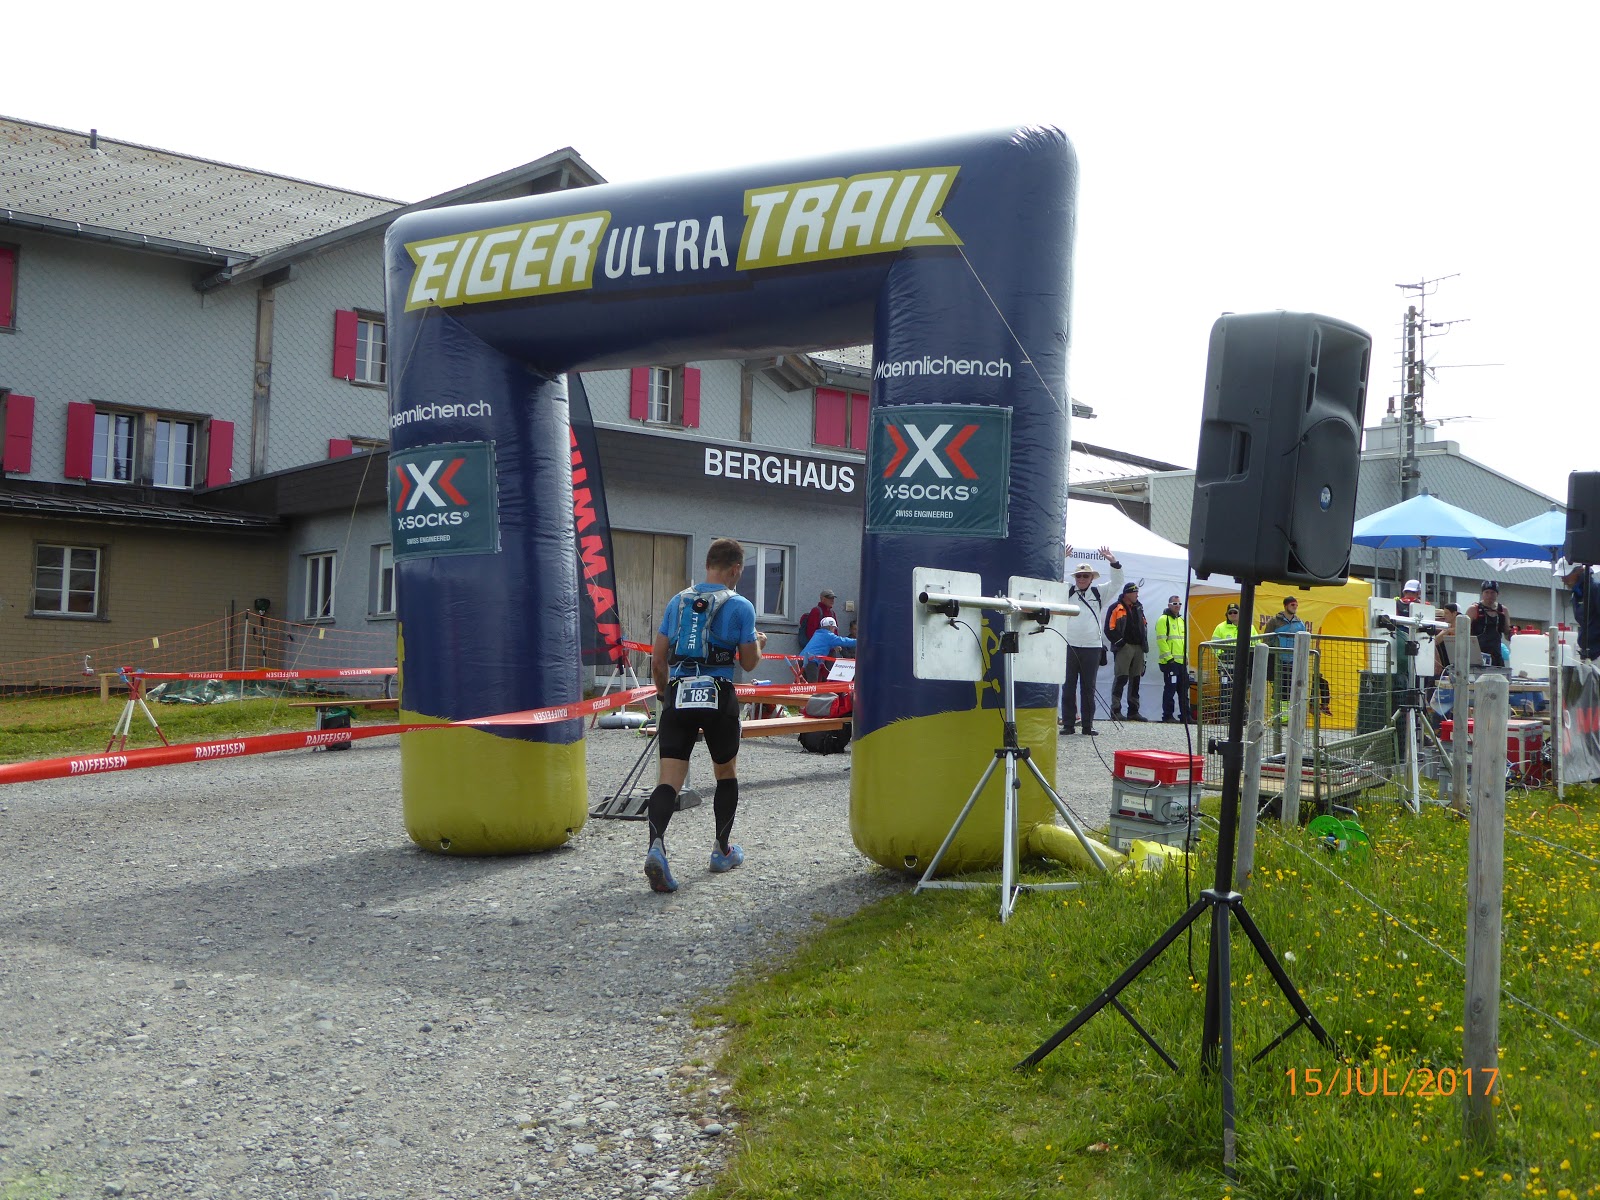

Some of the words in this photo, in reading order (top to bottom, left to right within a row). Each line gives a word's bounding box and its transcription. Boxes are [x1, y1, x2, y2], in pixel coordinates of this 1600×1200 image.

[410, 216, 605, 303] EIGER
[604, 215, 730, 279] ULTRA
[745, 174, 948, 261] TRAIL
[873, 355, 1012, 380] Maennlichen.ch
[389, 400, 492, 428] aennlichen.ch
[704, 447, 855, 493] BERGHAUS
[895, 510, 913, 518] SWISS
[914, 510, 954, 519] ENGINEERED
[419, 534, 451, 544] ENGINEERED
[690, 689, 709, 702] 185
[70, 755, 128, 774] RAIFFEISEN
[195, 742, 246, 759] RAIFFEISEN
[305, 732, 352, 746] RAIFFEISEN
[533, 707, 568, 721] RAIFFEISEN
